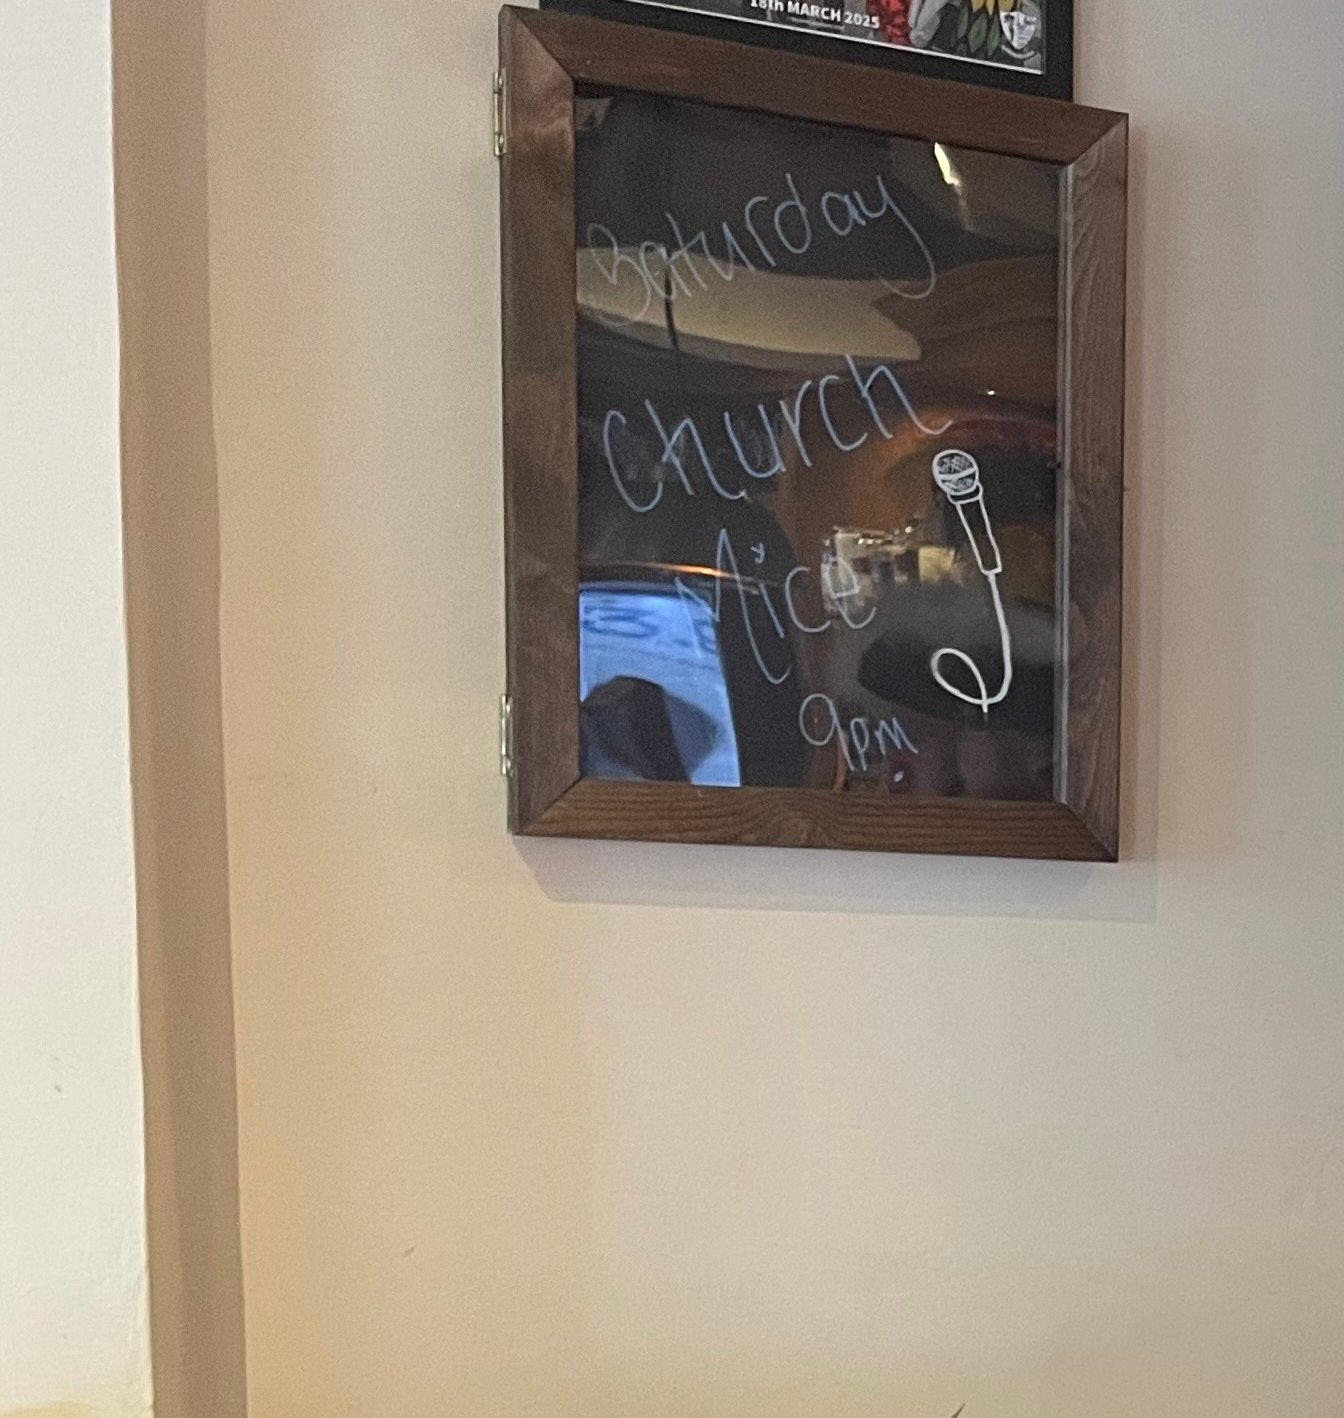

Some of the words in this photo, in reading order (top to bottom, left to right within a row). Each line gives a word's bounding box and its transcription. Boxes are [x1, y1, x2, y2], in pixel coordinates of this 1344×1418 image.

[787, 0, 841, 22] MARCH
[844, 11, 880, 28] 2025
[603, 354, 952, 512] Church
[675, 528, 876, 684] Mice
[800, 693, 919, 771] 9pm
